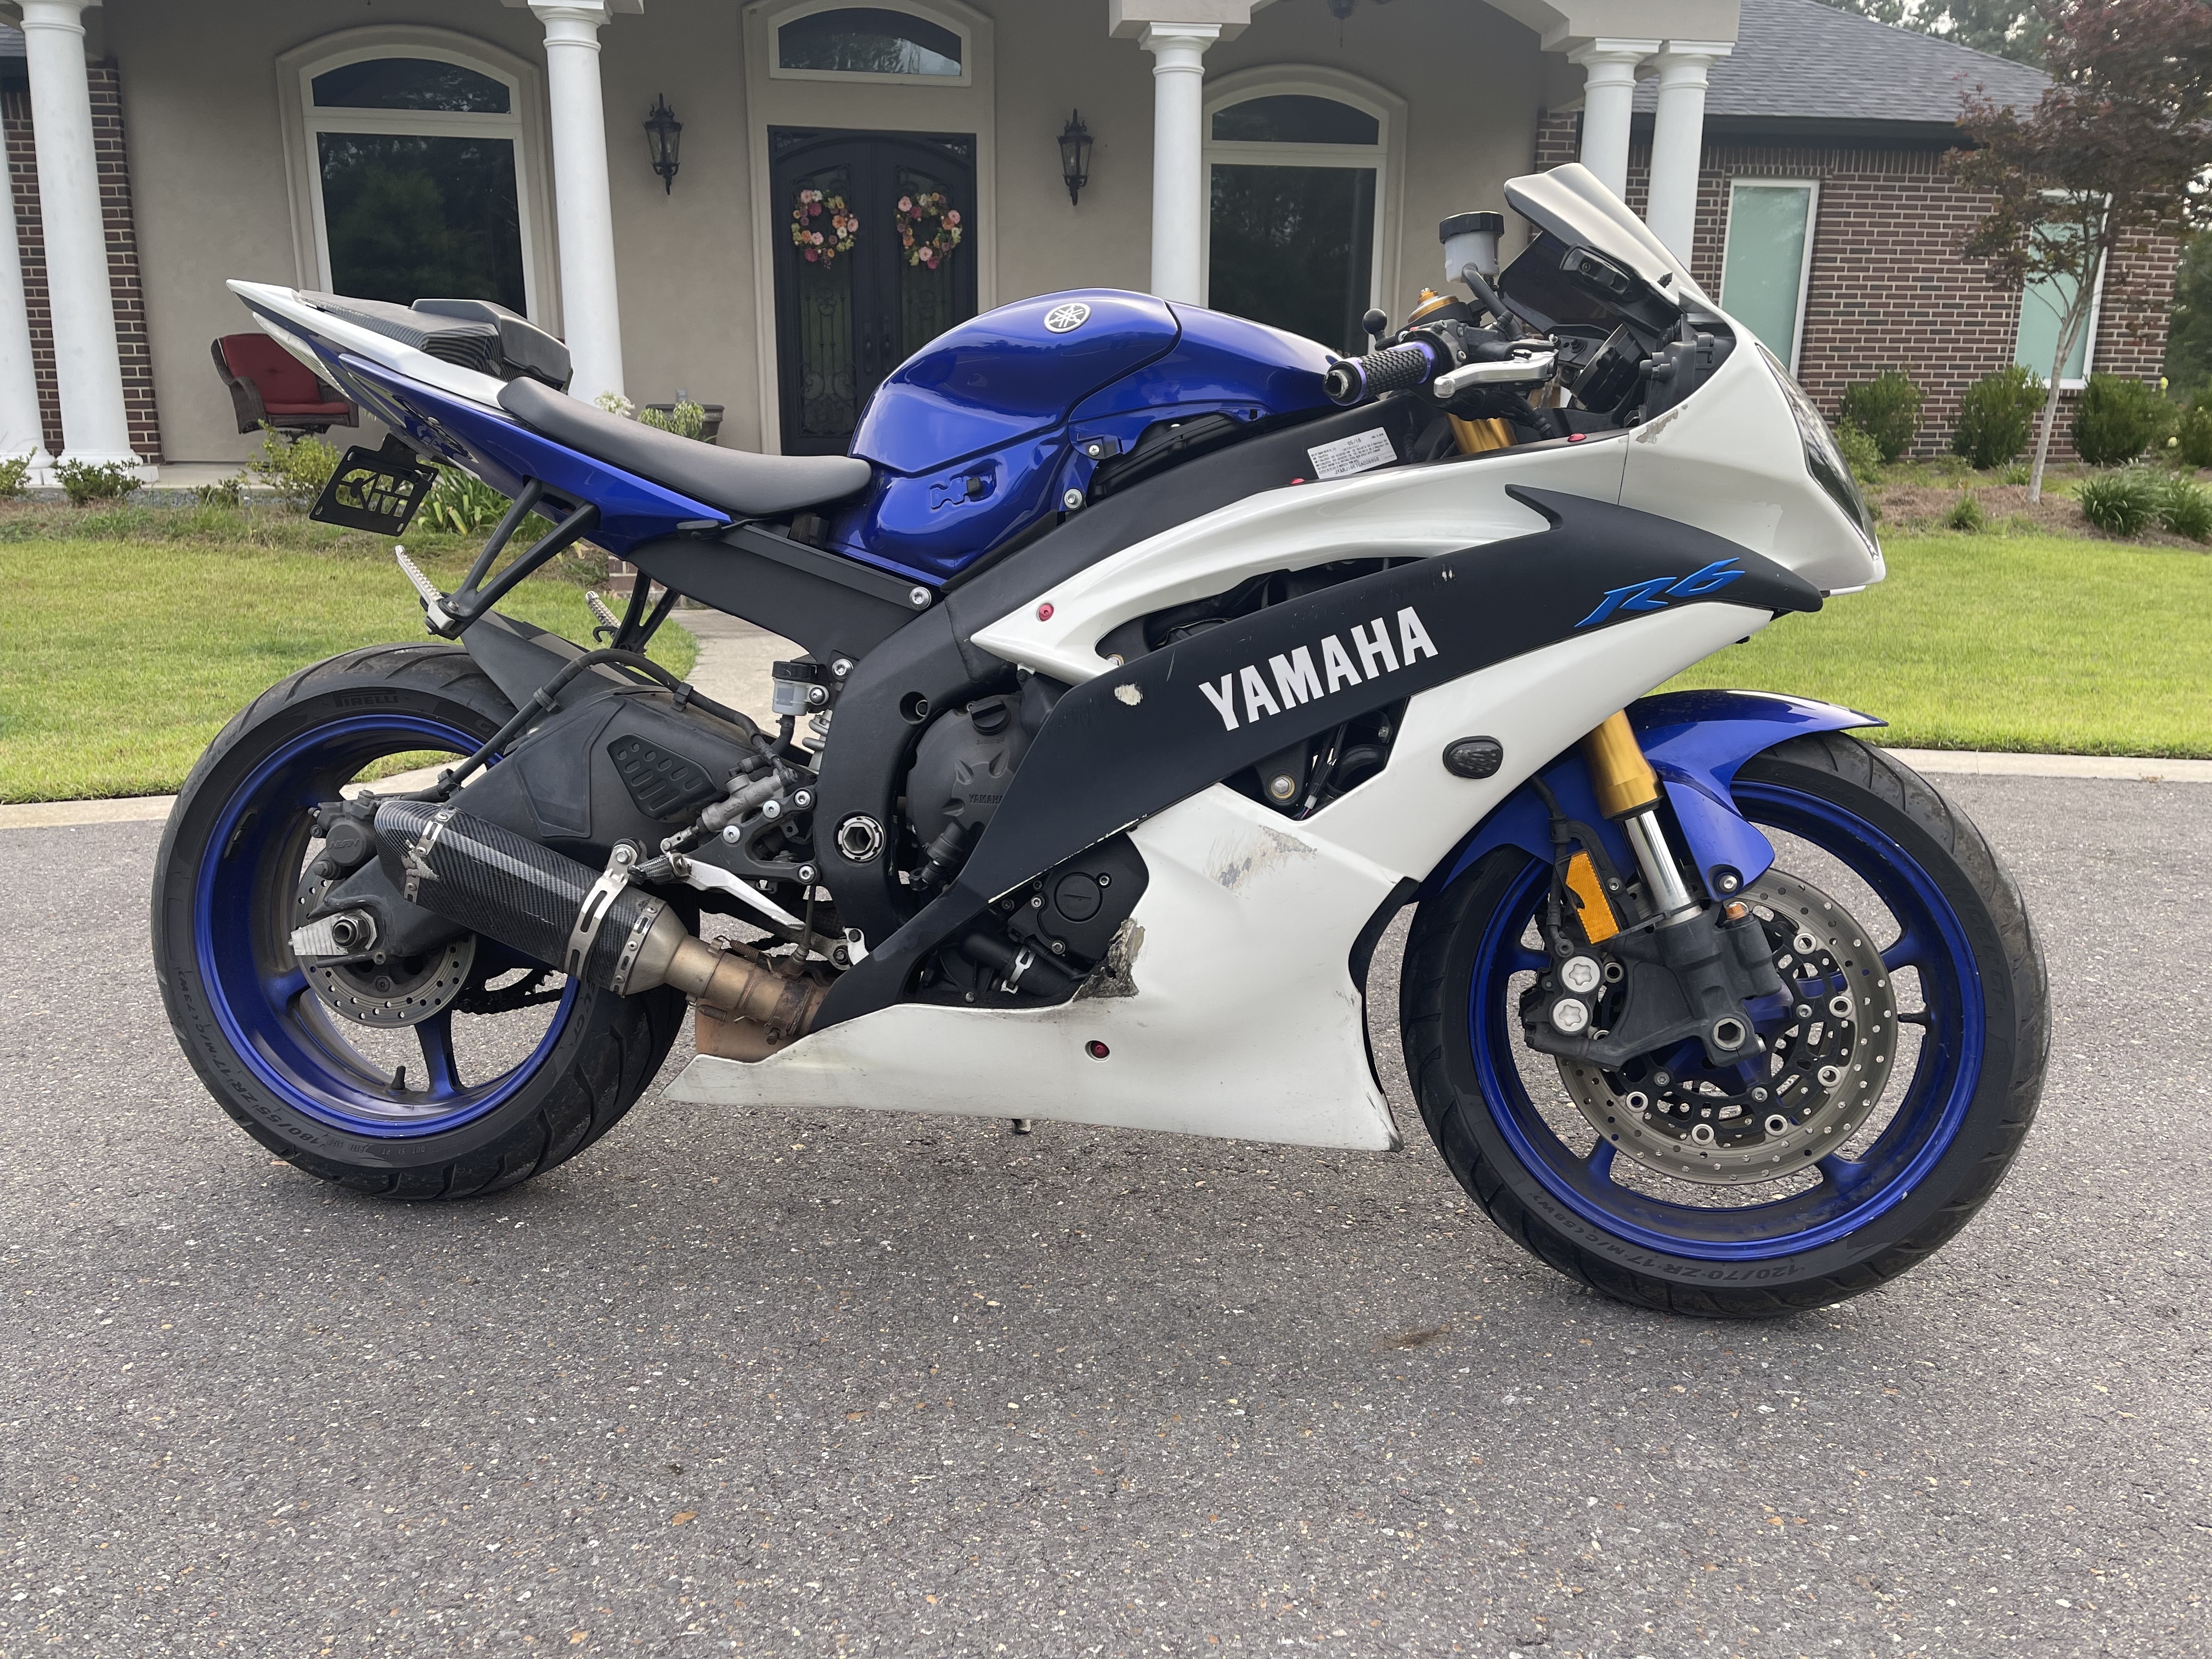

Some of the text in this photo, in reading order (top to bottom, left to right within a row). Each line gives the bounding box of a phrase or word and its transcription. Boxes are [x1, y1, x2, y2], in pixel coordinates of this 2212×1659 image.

[1573, 556, 1746, 628] R6
[1198, 606, 1438, 732] YAMAHA
[333, 689, 399, 707] PIRELLI
[212, 1058, 231, 1076] 17
[231, 1081, 258, 1103] ZR
[255, 1105, 319, 1146] 180/55
[412, 1146, 426, 1154] DOT
[1626, 1255, 1654, 1267] 17
[1663, 1263, 1702, 1278] ZR
[1708, 1264, 1798, 1280] 120/70
